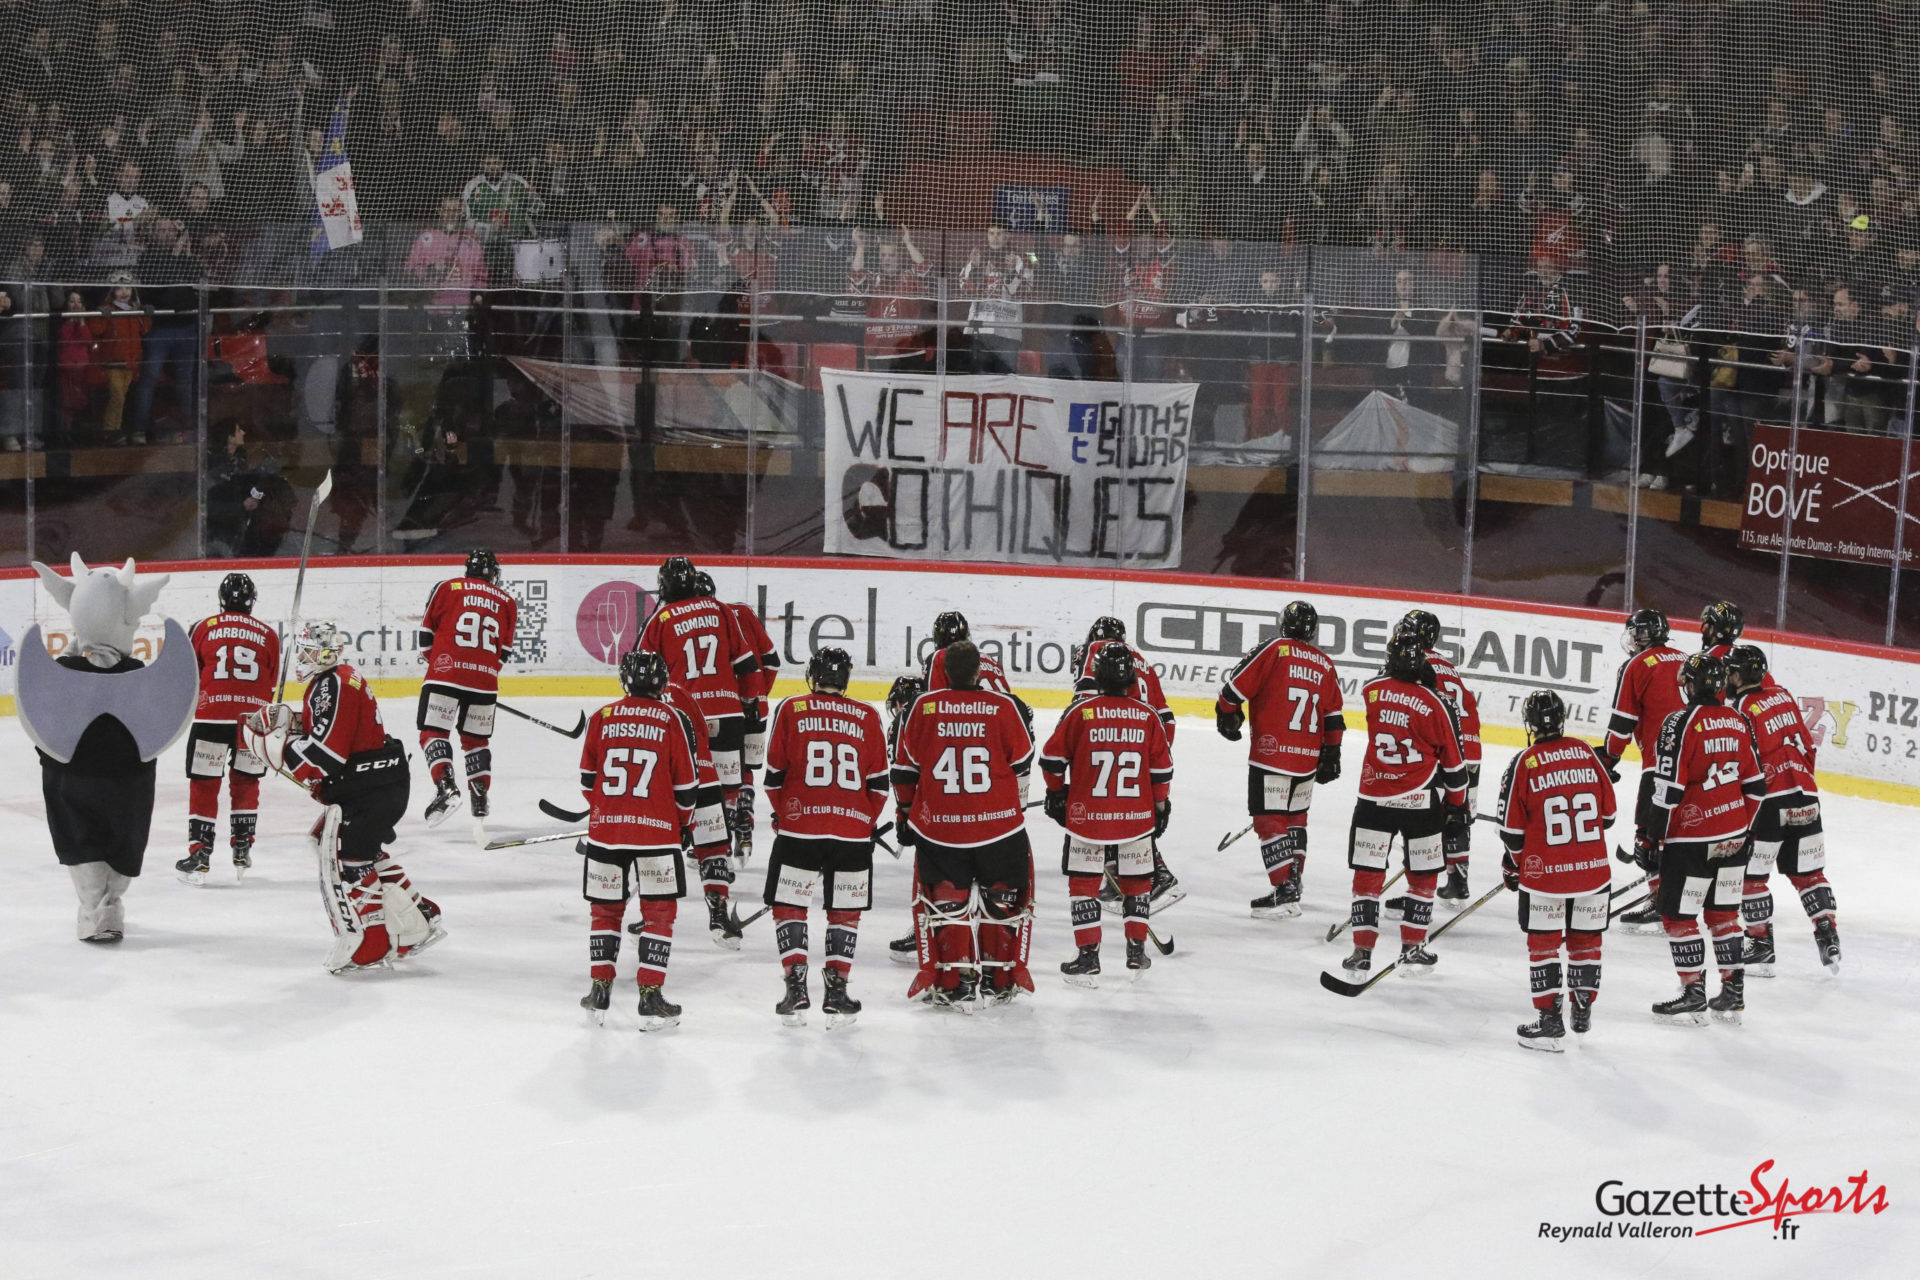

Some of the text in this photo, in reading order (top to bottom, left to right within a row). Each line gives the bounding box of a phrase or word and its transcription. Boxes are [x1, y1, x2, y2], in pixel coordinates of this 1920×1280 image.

[837, 383, 1055, 470] WE ARE
[1747, 482, 1822, 522] BOVÉ
[1742, 530, 1756, 544] 115,
[1757, 534, 1769, 544] rue
[1770, 533, 1806, 549] Alendre
[1808, 537, 1832, 551] Dumas
[1838, 542, 1865, 559] Parking
[463, 595, 500, 614] KURALT
[455, 611, 500, 654] 92
[674, 615, 719, 636] ROMAND
[208, 628, 266, 647] NARBONNE
[214, 645, 259, 681] 19
[683, 634, 718, 680] 17
[1437, 627, 1603, 684] SAINT
[1289, 664, 1324, 686] HALLEY
[810, 699, 867, 720] Lhotellier
[938, 701, 1000, 715] Lhotellier
[1288, 686, 1320, 733] 71
[1380, 689, 1433, 717] Lhotellier
[614, 705, 671, 723] Lhotellier
[1096, 707, 1150, 720] Lhotellier
[1379, 709, 1410, 729] SUIRE
[602, 723, 666, 742] PRISSAINT
[937, 722, 986, 738] SAVOYE
[1090, 728, 1145, 744] COULAUD
[1374, 732, 1423, 764] 21
[356, 758, 400, 772] CCM
[602, 748, 658, 798] 57
[804, 740, 862, 792] 88
[932, 746, 992, 795] 46
[1091, 750, 1142, 797] 72
[1530, 768, 1598, 793] LAAKKONEN
[606, 815, 622, 823] CLUB
[803, 806, 811, 814] LE
[813, 805, 830, 814] CLUB
[933, 807, 1016, 823] LE CLUB DES BÂTISSEURS
[1096, 812, 1112, 821] CLUB
[1544, 792, 1600, 846] 62
[1704, 810, 1712, 818] LE
[1713, 804, 1730, 816] CLUB
[1787, 808, 1816, 818] Auchan
[1070, 846, 1092, 855] INFRA
[1356, 841, 1376, 850] INFRA
[1545, 859, 1588, 874] LE CLUB DES
[779, 878, 802, 889] INFRA
[334, 884, 357, 933] CCM
[1573, 905, 1597, 913] INFRA
[1680, 942, 1702, 952] PETIT
